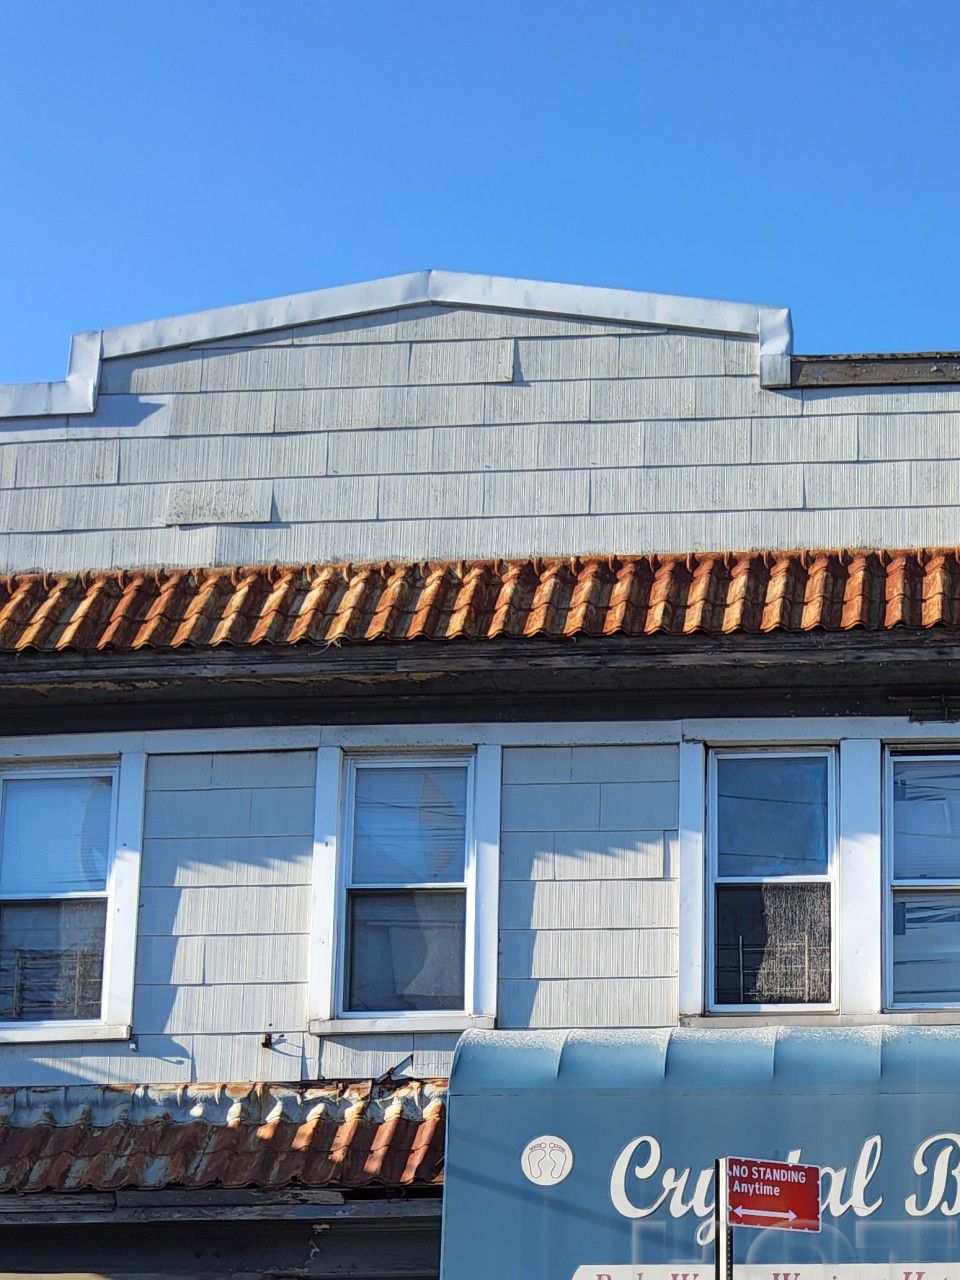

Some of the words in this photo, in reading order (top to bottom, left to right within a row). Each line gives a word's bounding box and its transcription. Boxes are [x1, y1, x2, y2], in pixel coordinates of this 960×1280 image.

[732, 1164, 749, 1178] NO
[751, 1166, 807, 1184] STANDING
[609, 1133, 884, 1246] Cryal
[733, 1180, 781, 1196] Anytime
